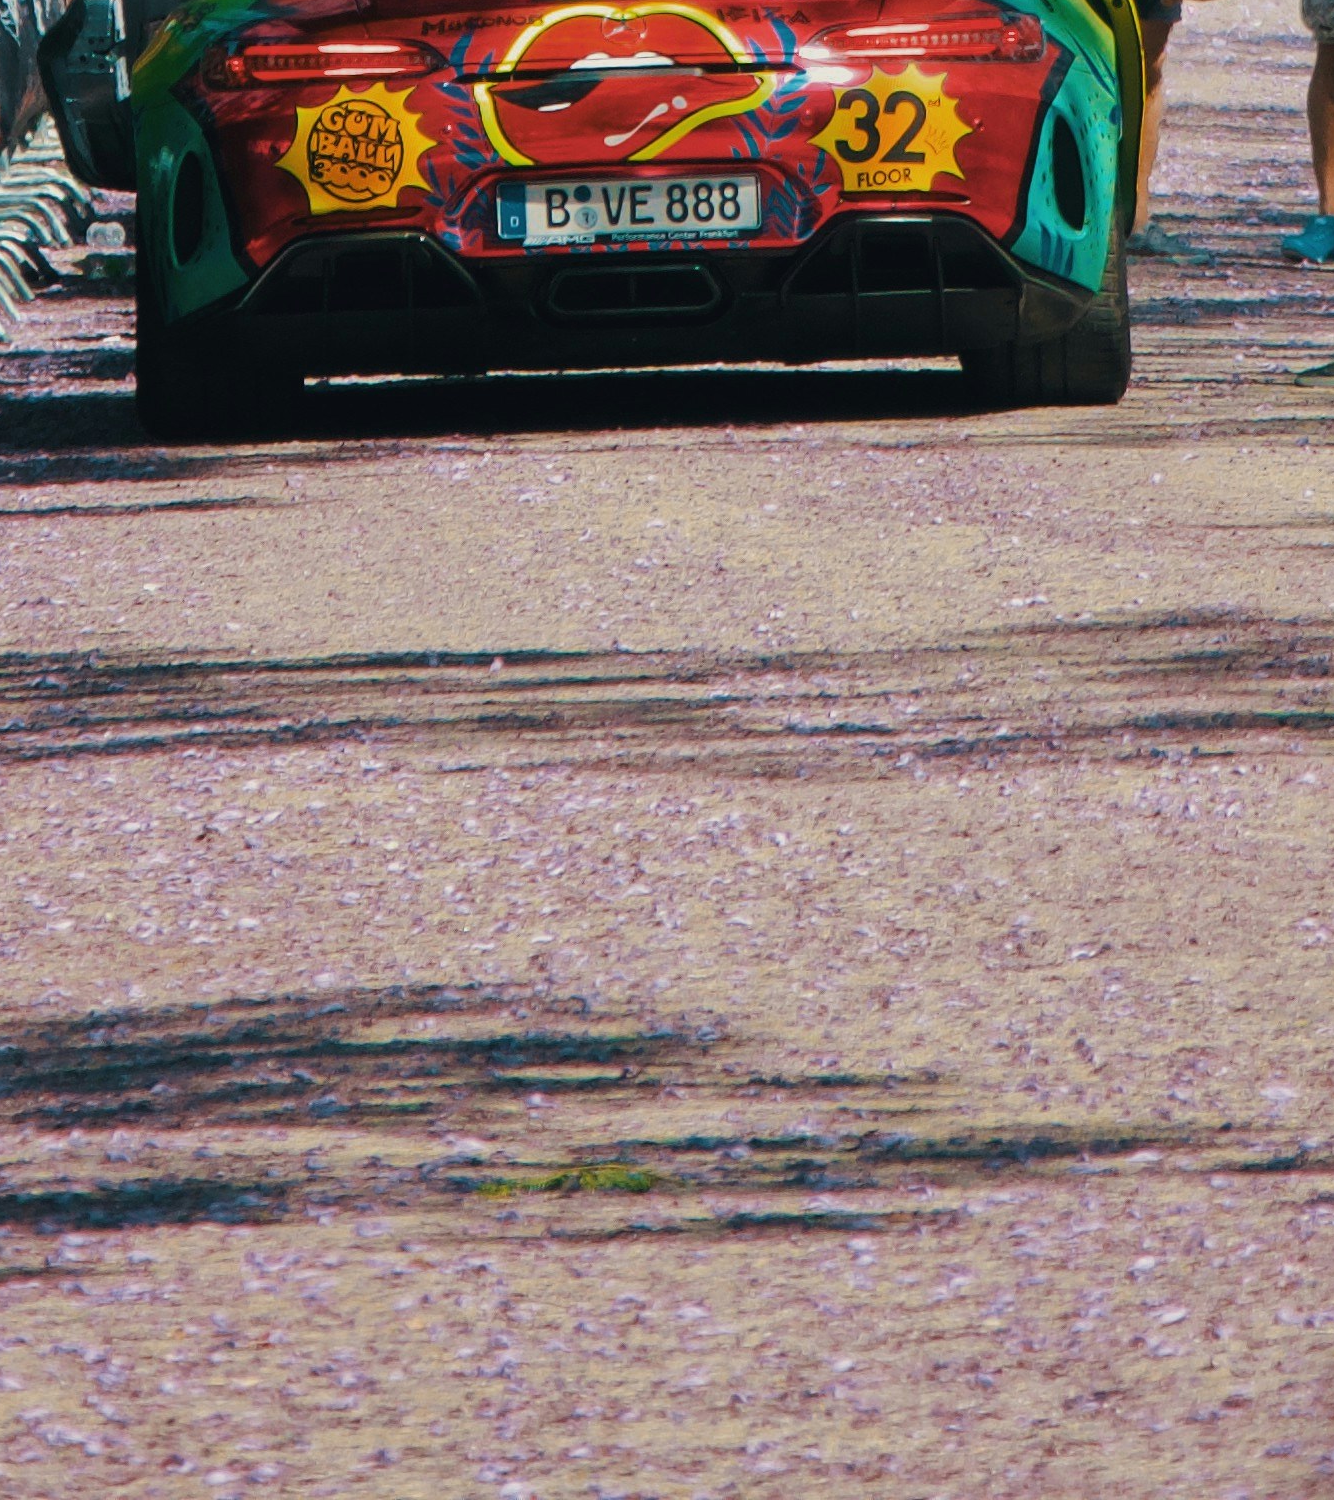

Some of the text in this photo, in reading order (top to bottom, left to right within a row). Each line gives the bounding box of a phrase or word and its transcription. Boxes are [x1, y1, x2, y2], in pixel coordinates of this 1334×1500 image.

[320, 105, 400, 143] GUM
[310, 130, 402, 171] BALL
[312, 158, 393, 195] 3000
[857, 168, 913, 188] FLOOR
[545, 181, 741, 229] B VE 888
